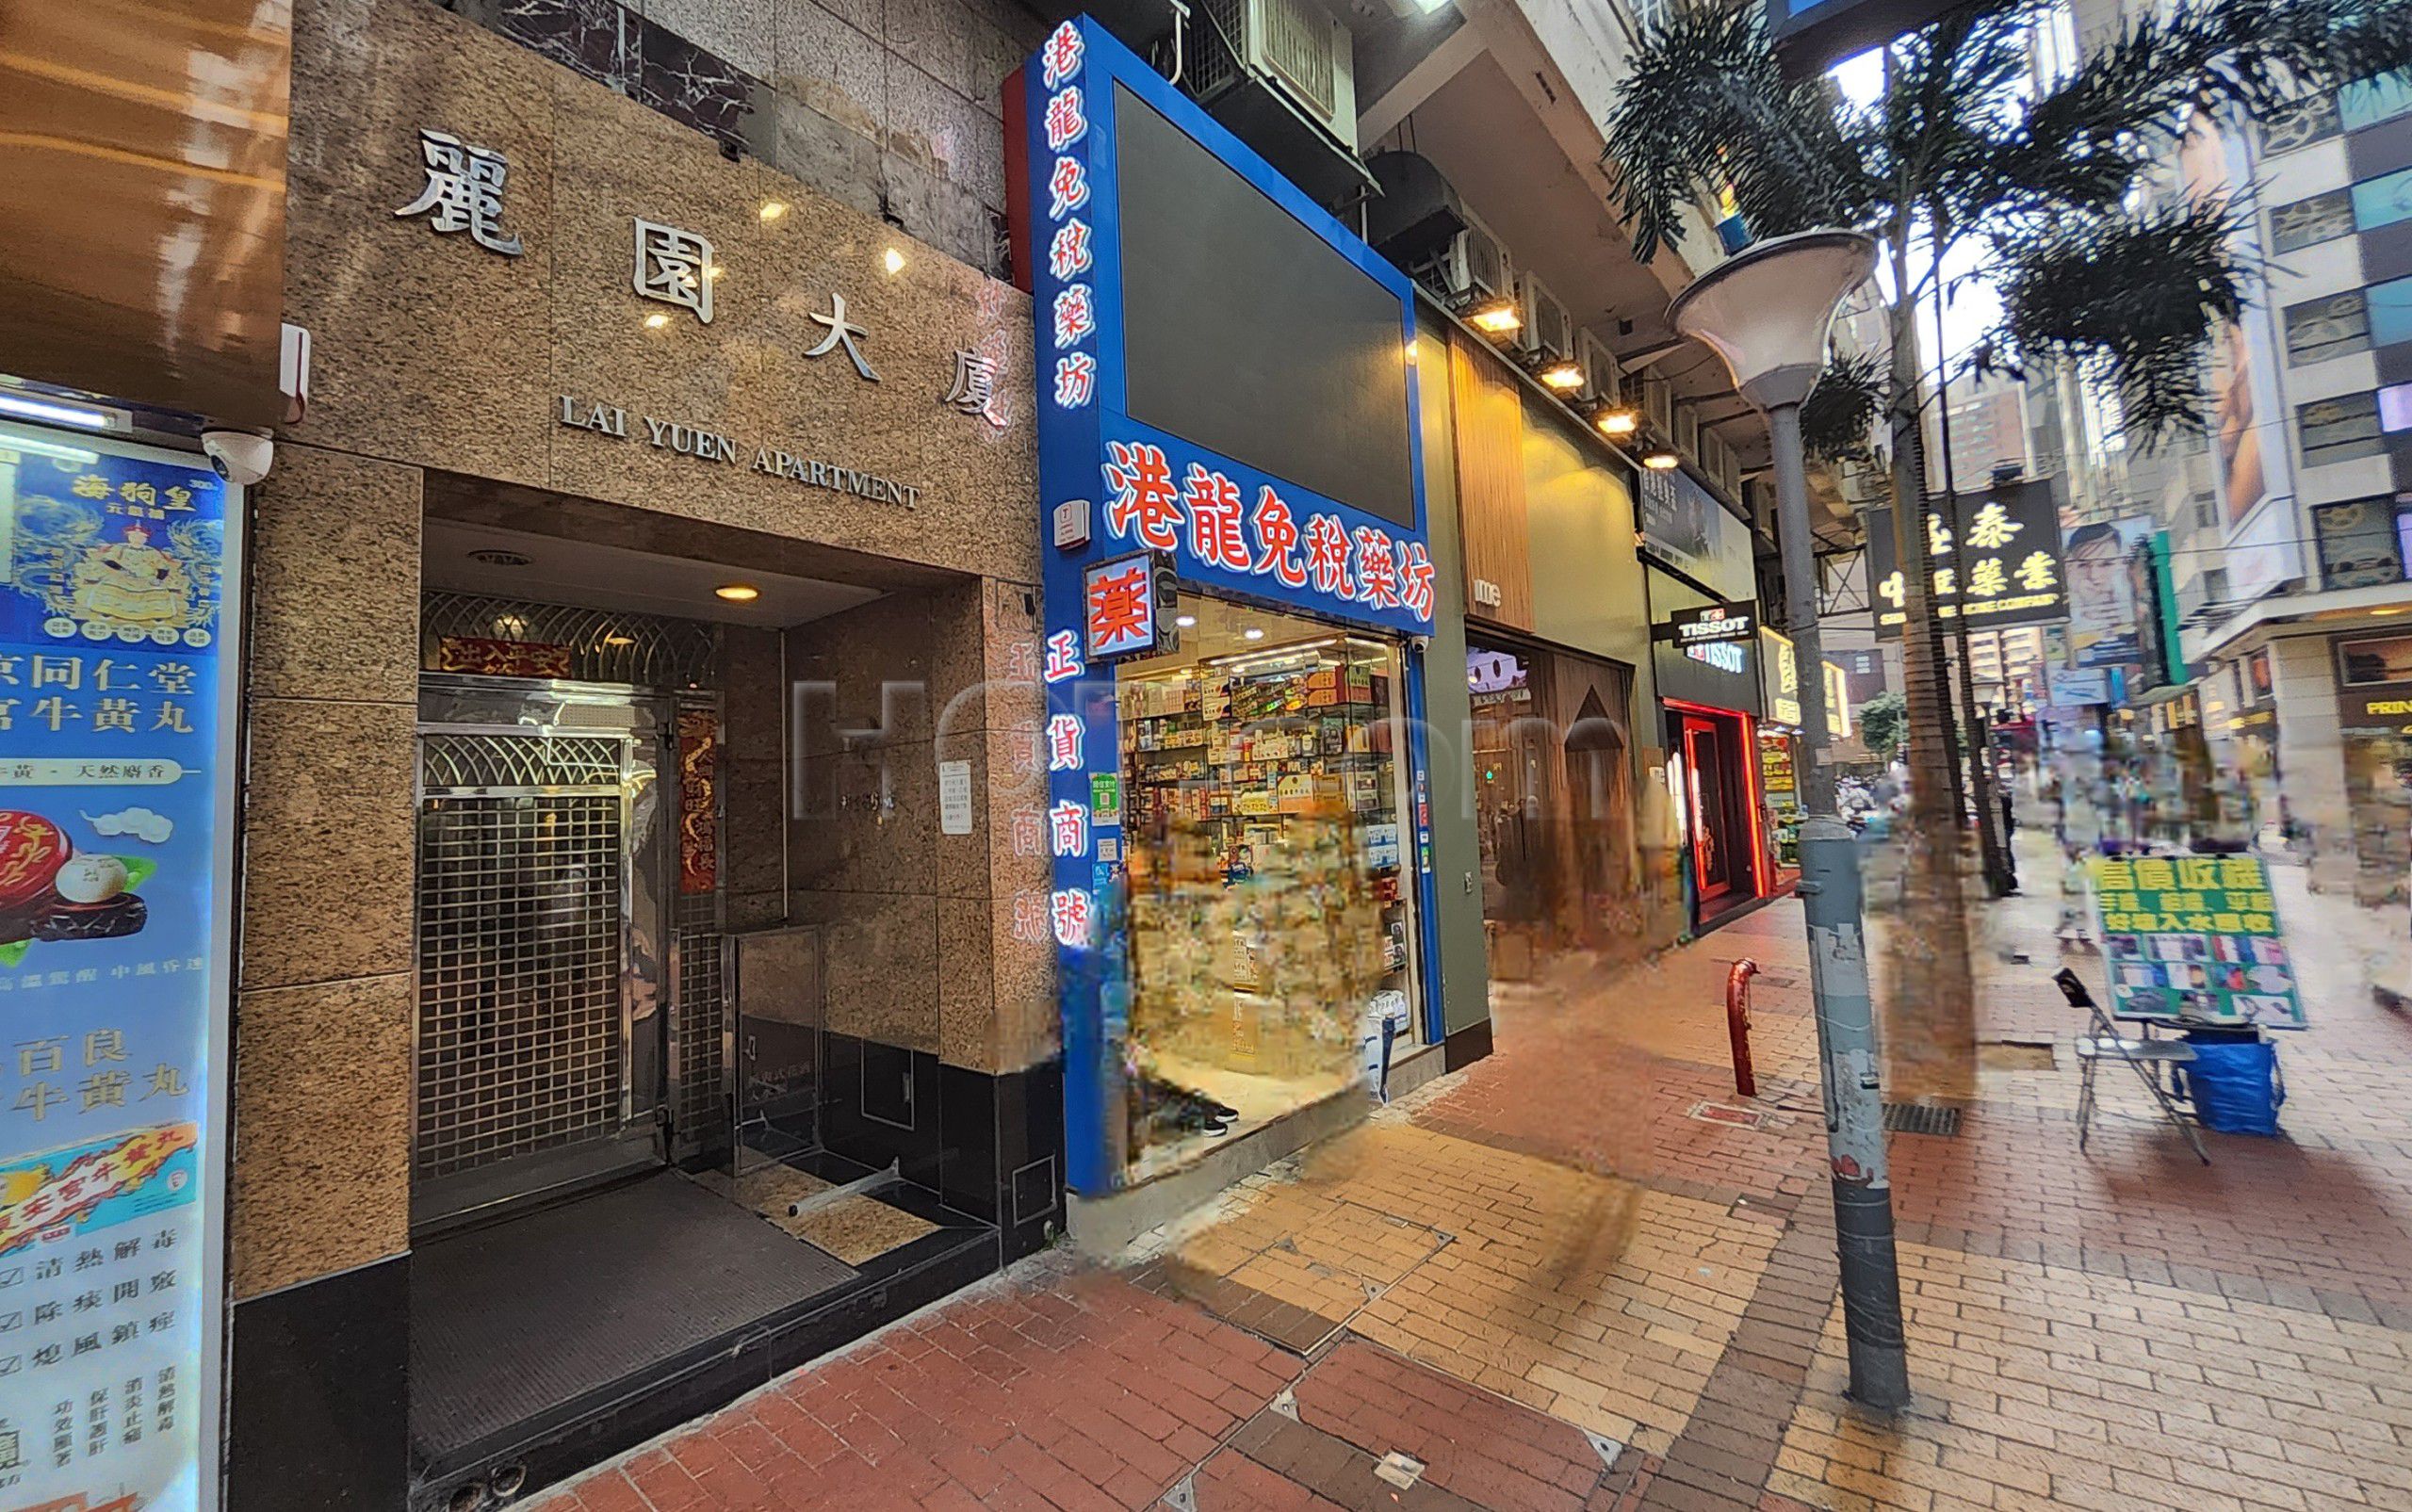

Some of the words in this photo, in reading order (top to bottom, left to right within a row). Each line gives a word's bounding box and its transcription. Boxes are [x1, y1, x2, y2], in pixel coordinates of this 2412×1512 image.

[395, 128, 1008, 429] 麗園大廈
[1043, 20, 1097, 409] 港龍免稅藥坊
[561, 396, 627, 439] LAI
[644, 415, 736, 465] YUEN
[752, 446, 921, 511] APARTMENT
[1101, 440, 1436, 622] 港龍免稅藥坊
[1678, 616, 1750, 637] TISSOT
[1044, 629, 1090, 947] 正貨商號
[36, 1228, 178, 1280] 清熱解毒
